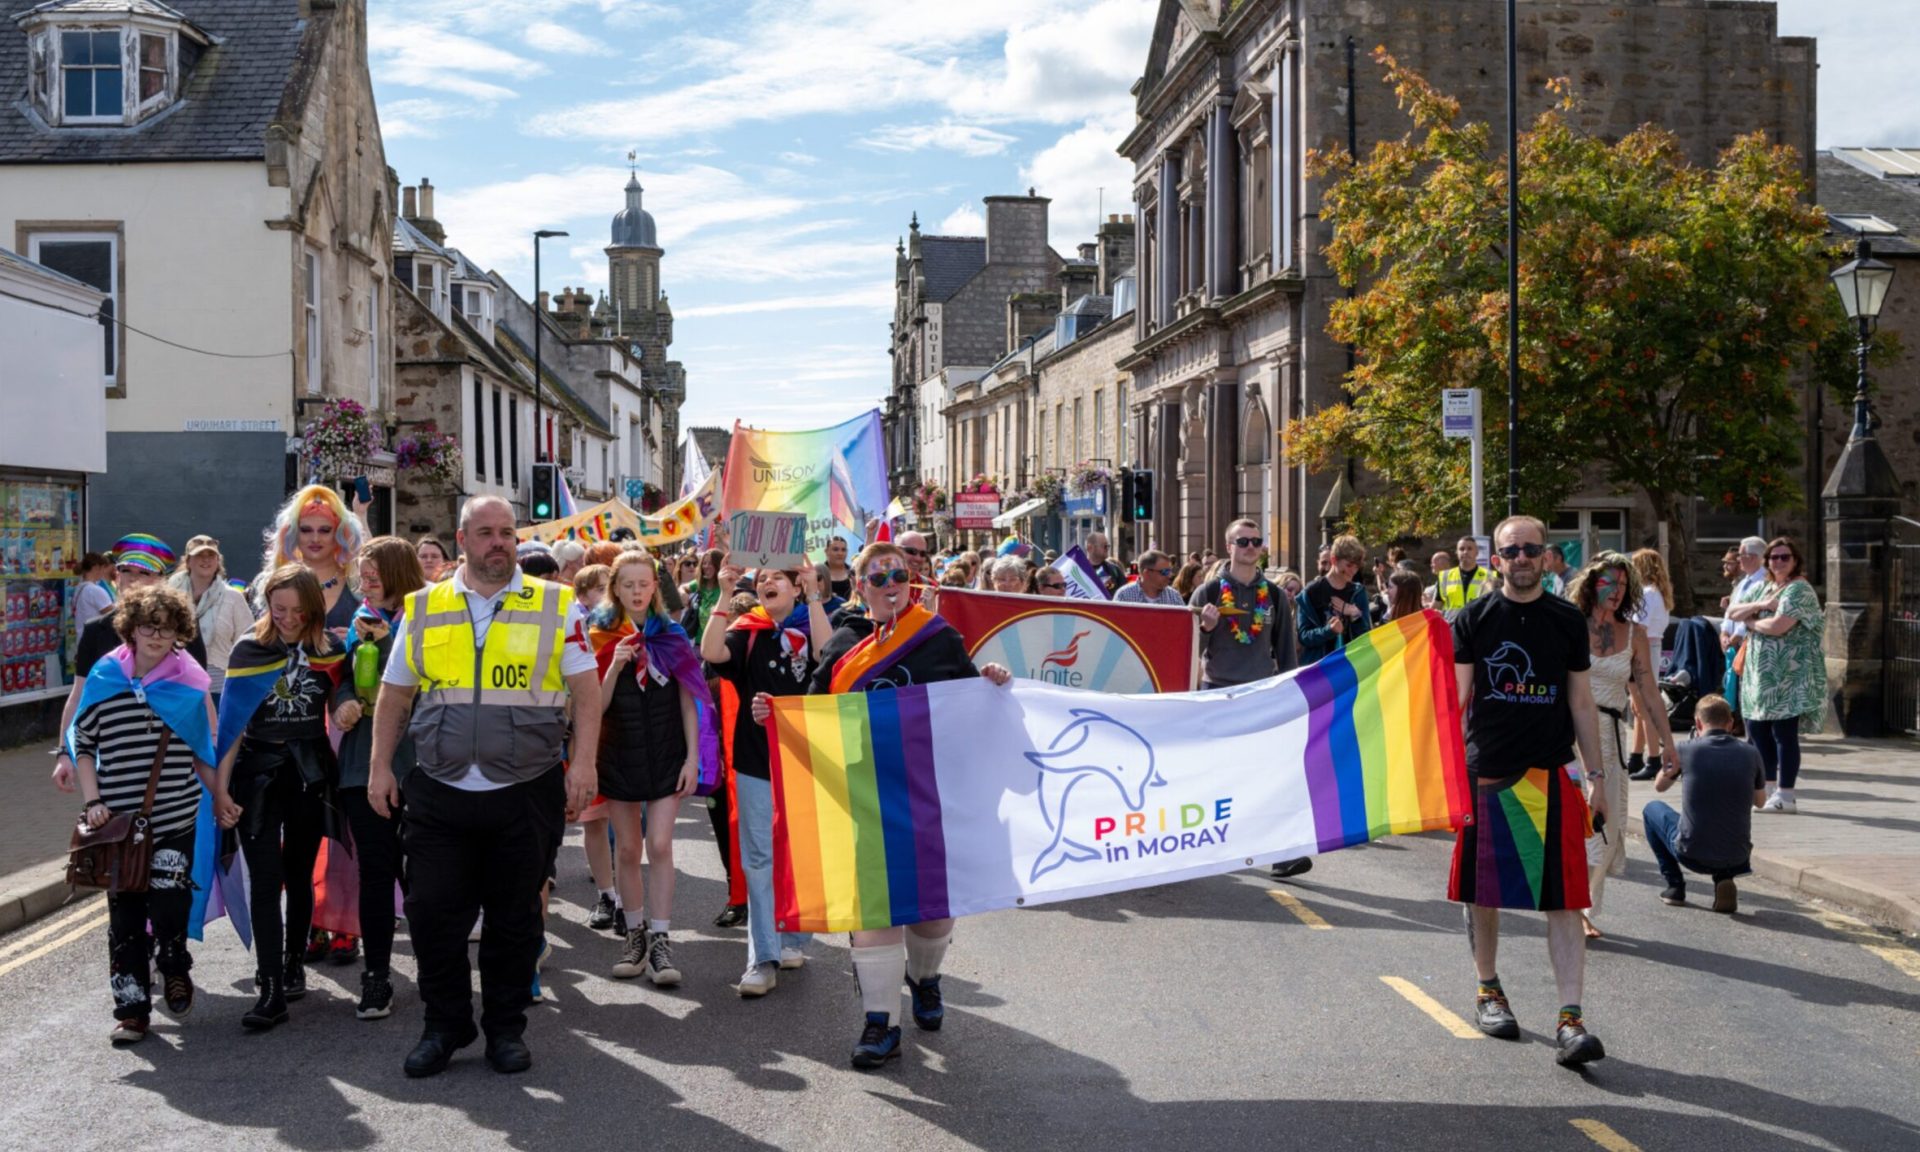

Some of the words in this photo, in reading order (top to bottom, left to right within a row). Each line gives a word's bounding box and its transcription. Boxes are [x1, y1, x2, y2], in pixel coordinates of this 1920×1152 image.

[240, 420, 276, 431] STREET
[753, 463, 816, 483] UNISON
[492, 664, 528, 689] 005
[1504, 682, 1557, 695] PRIDE
[1507, 693, 1517, 702] in
[1520, 695, 1556, 704] MORAY
[1094, 797, 1233, 841] PRIDE
[1105, 842, 1129, 863] in
[1137, 823, 1230, 858] MORAY
